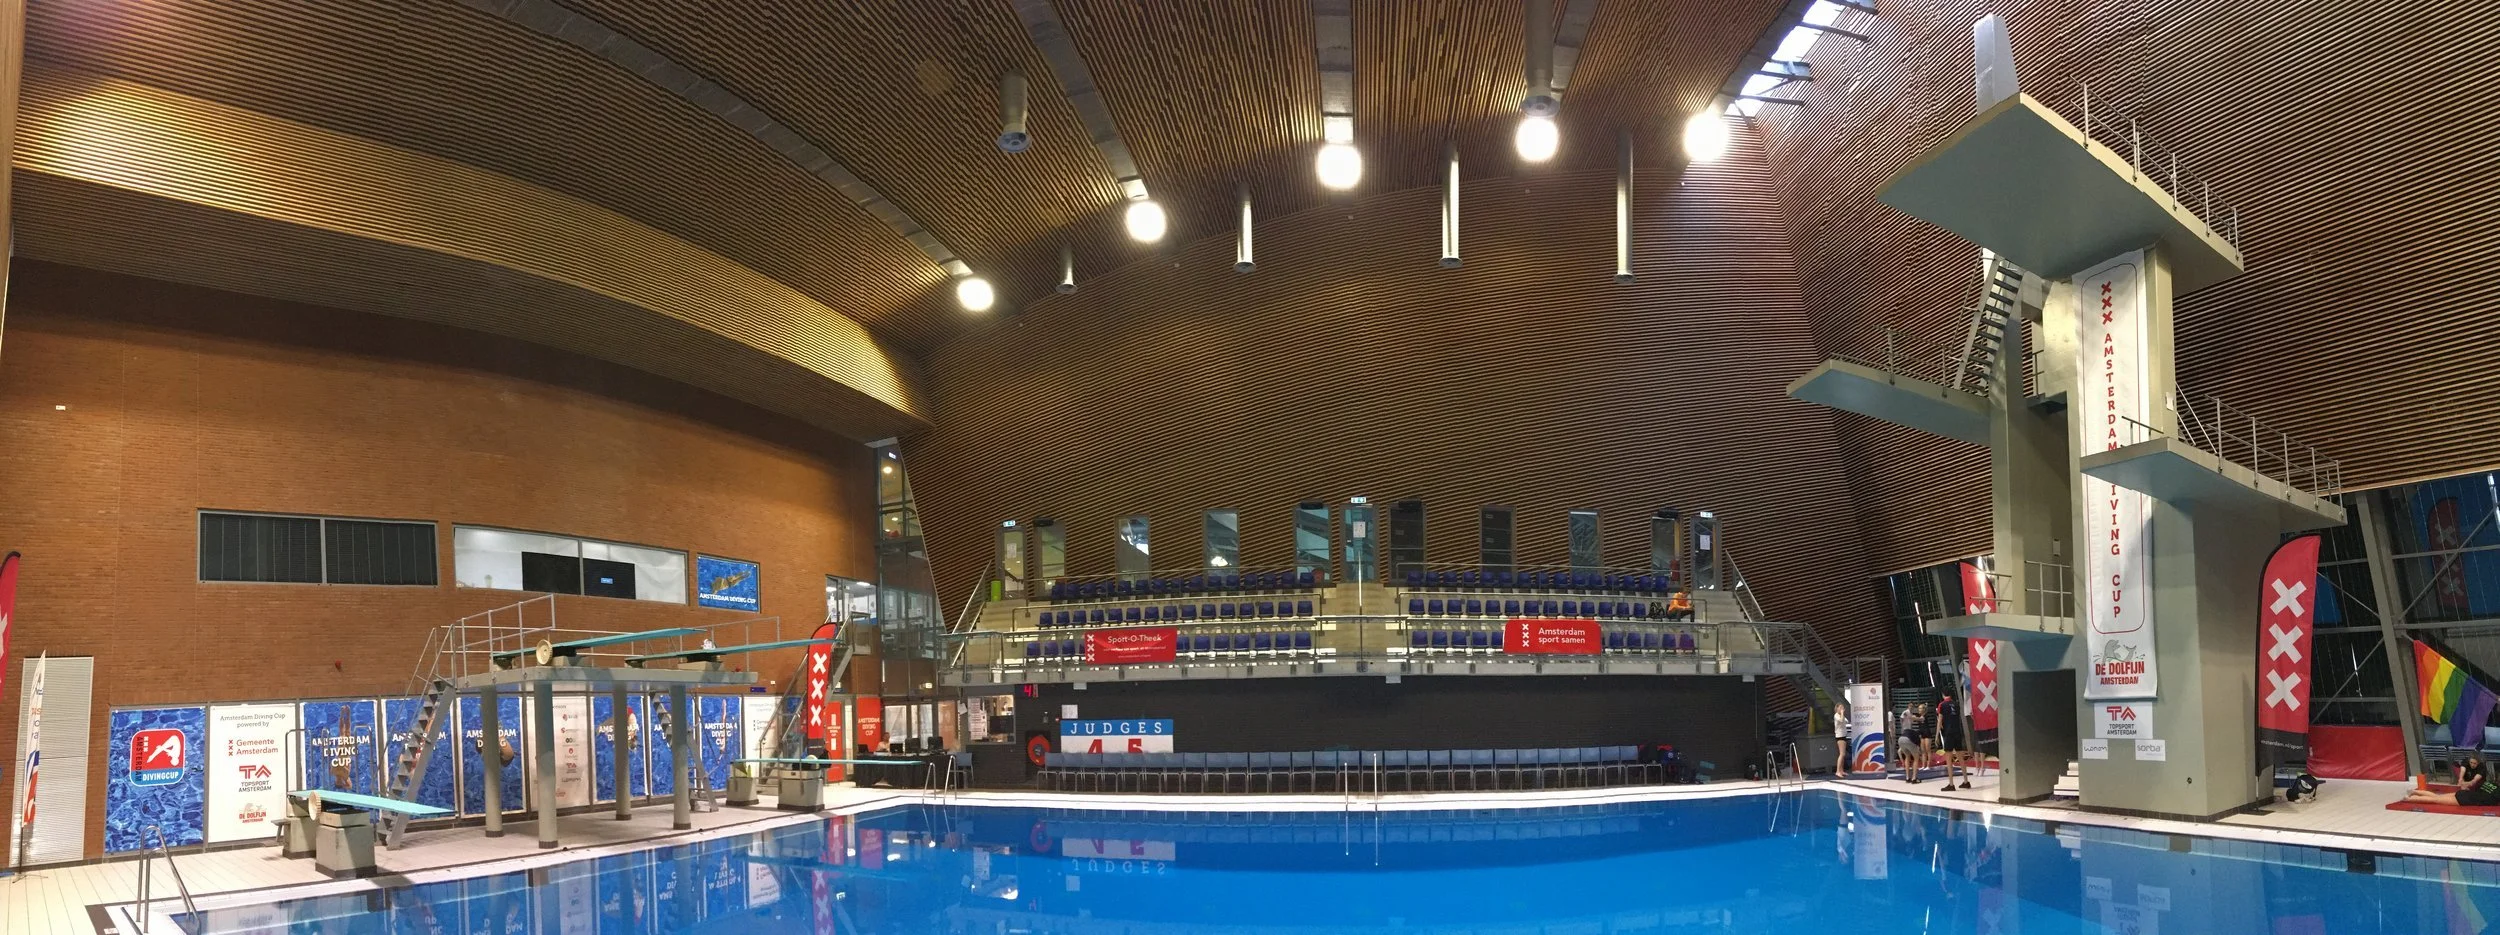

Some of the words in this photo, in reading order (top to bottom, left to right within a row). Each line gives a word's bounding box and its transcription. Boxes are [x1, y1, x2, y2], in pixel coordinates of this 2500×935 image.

[2110, 485, 2120, 556] IVING
[2112, 575, 2121, 618] CUP
[1538, 627, 1585, 636] Amsterdam
[1108, 634, 1162, 644] Sport-O-Theek
[1538, 636, 1559, 645] sport
[2095, 663, 2106, 676] DE
[2109, 661, 2145, 675] DOLFIJN
[2100, 676, 2139, 685] AMSTERDAM
[1070, 722, 1162, 734] JUDGES
[466, 729, 517, 738] AMSDAM
[236, 739, 274, 747] Gemeente
[236, 747, 278, 755] Amsterdam
[331, 758, 352, 767] CUP
[142, 771, 179, 781] DIVINGCUP
